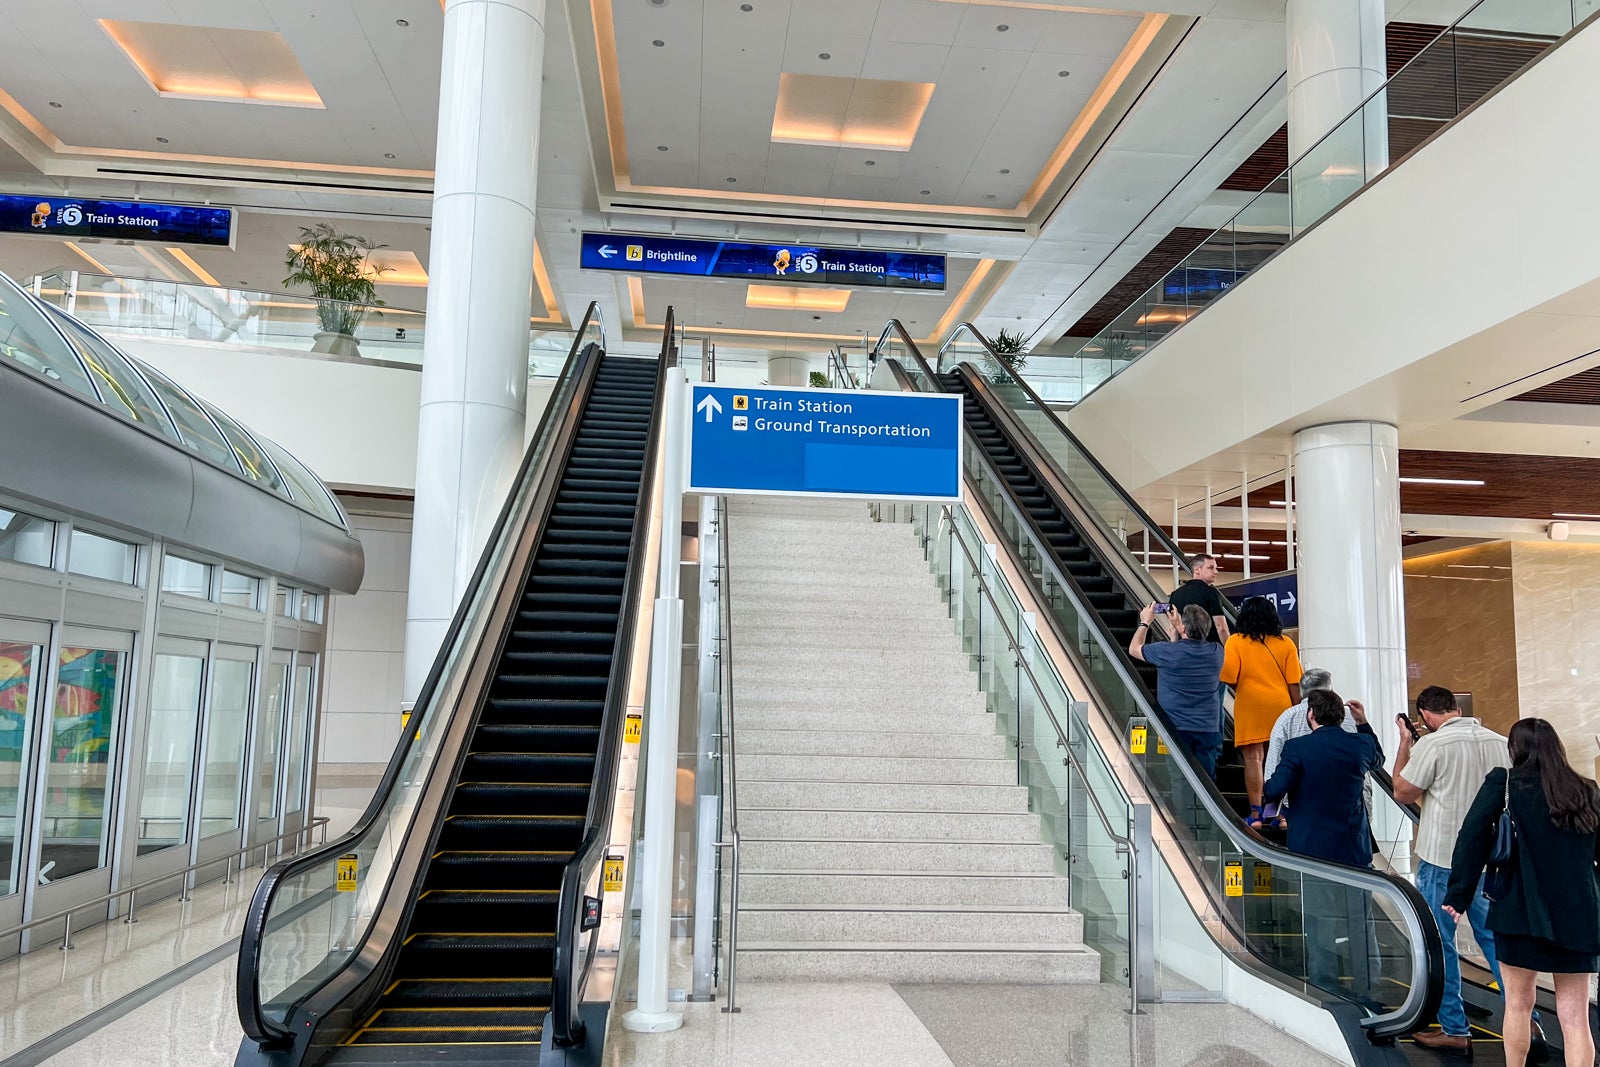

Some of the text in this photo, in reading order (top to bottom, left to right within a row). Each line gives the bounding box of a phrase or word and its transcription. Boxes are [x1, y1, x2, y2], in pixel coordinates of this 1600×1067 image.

[86, 213, 159, 227] Train Station
[646, 249, 698, 262] Brightline
[821, 260, 885, 273] Train Station
[754, 397, 853, 413] Train Station
[754, 418, 931, 437] Ground Transportation
